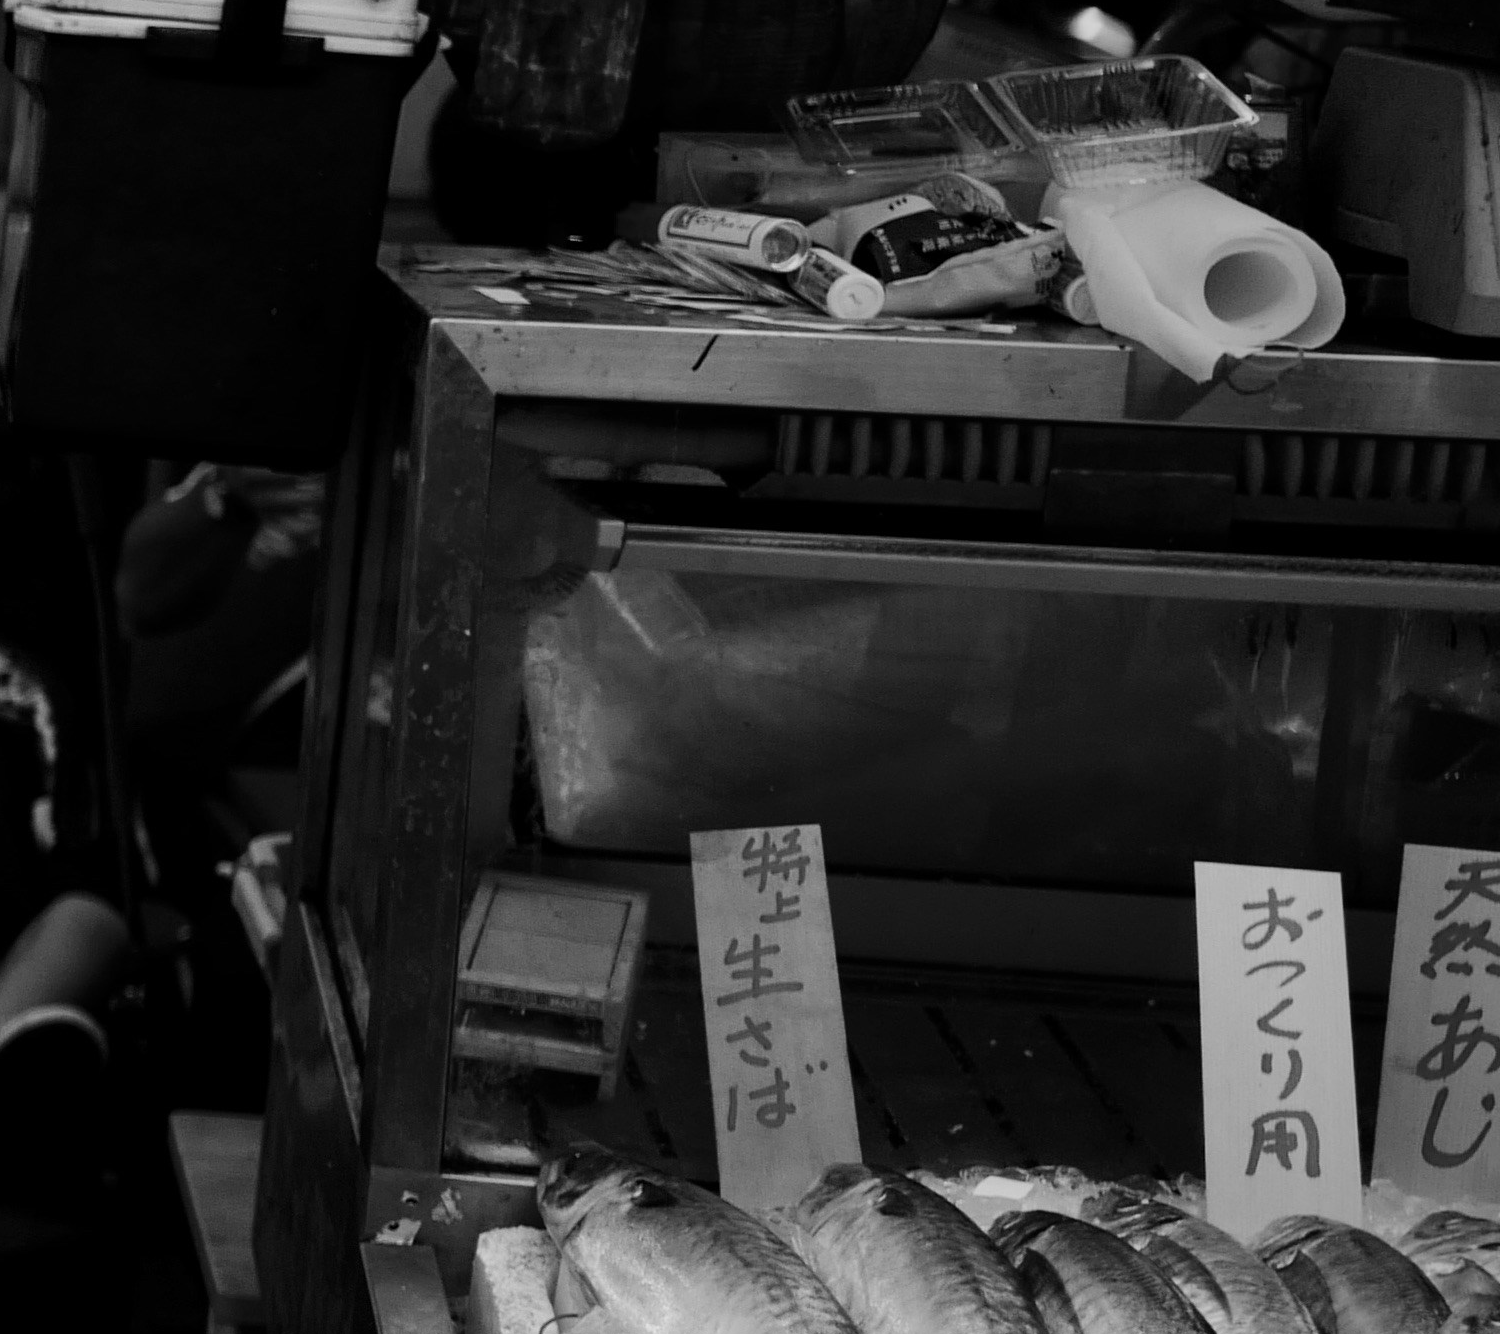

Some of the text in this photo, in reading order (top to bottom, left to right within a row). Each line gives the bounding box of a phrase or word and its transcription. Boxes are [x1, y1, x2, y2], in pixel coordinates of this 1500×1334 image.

[1241, 886, 1324, 1180] おつくり用
